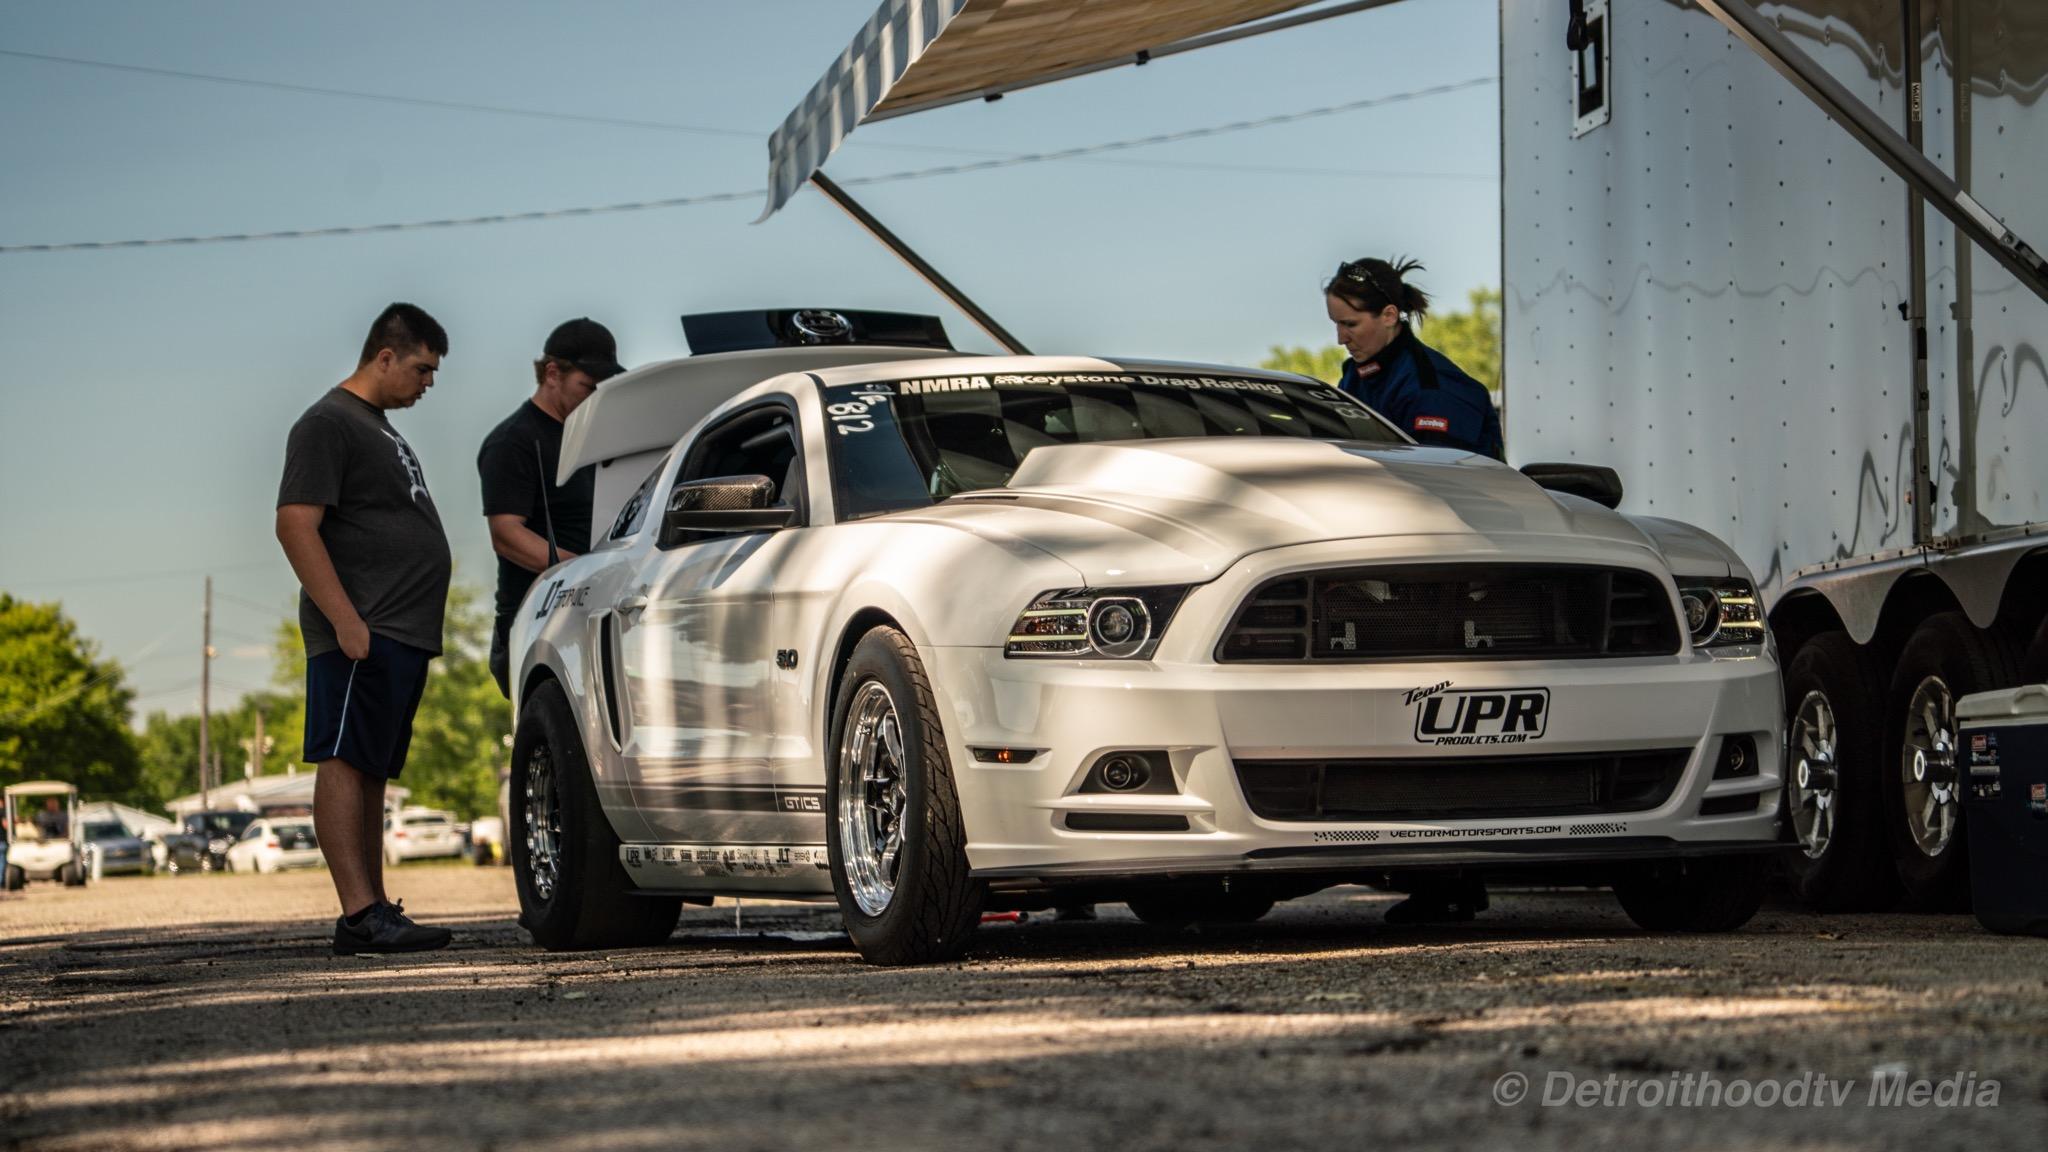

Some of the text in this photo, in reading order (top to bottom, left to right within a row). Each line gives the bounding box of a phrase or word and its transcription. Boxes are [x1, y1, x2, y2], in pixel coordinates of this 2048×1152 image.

[900, 375, 1284, 395] NMRA Keystone Drag Racing
[1402, 680, 1454, 706] Team
[1420, 693, 1546, 735] UPR
[1435, 734, 1528, 746] PRODUCTS.COM
[1390, 826, 1561, 838] VECTORMOTORSPORTS.COM
